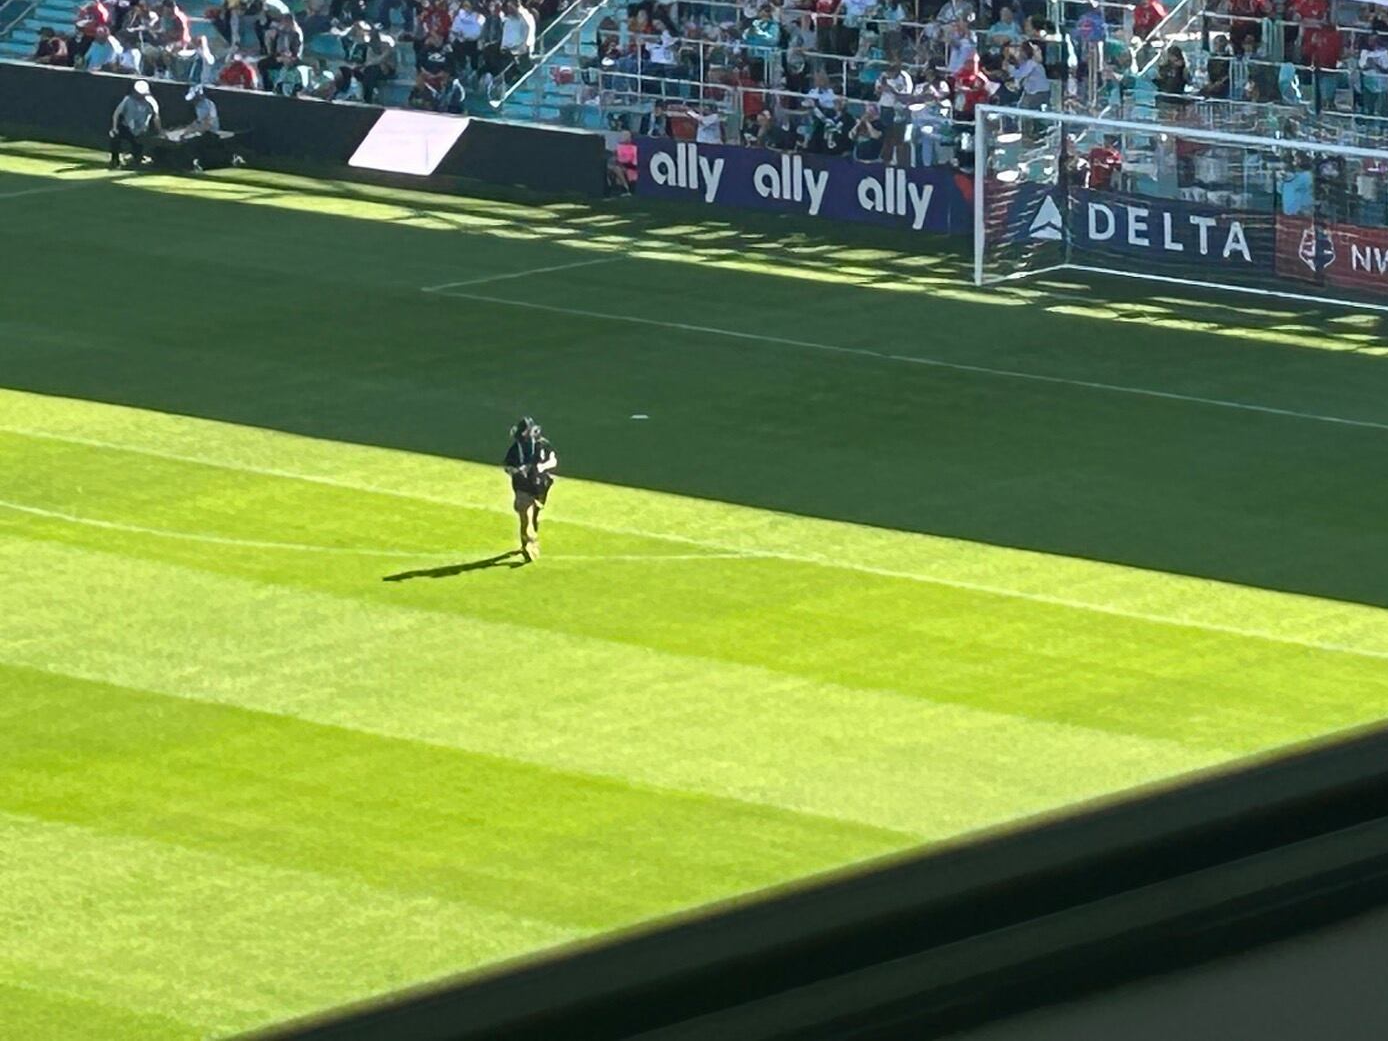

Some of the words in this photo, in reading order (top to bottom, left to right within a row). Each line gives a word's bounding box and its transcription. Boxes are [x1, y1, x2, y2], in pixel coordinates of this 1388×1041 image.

[650, 143, 724, 203] ally
[754, 155, 829, 215] ally
[857, 167, 933, 230] ally
[1088, 202, 1252, 263] DELTA
